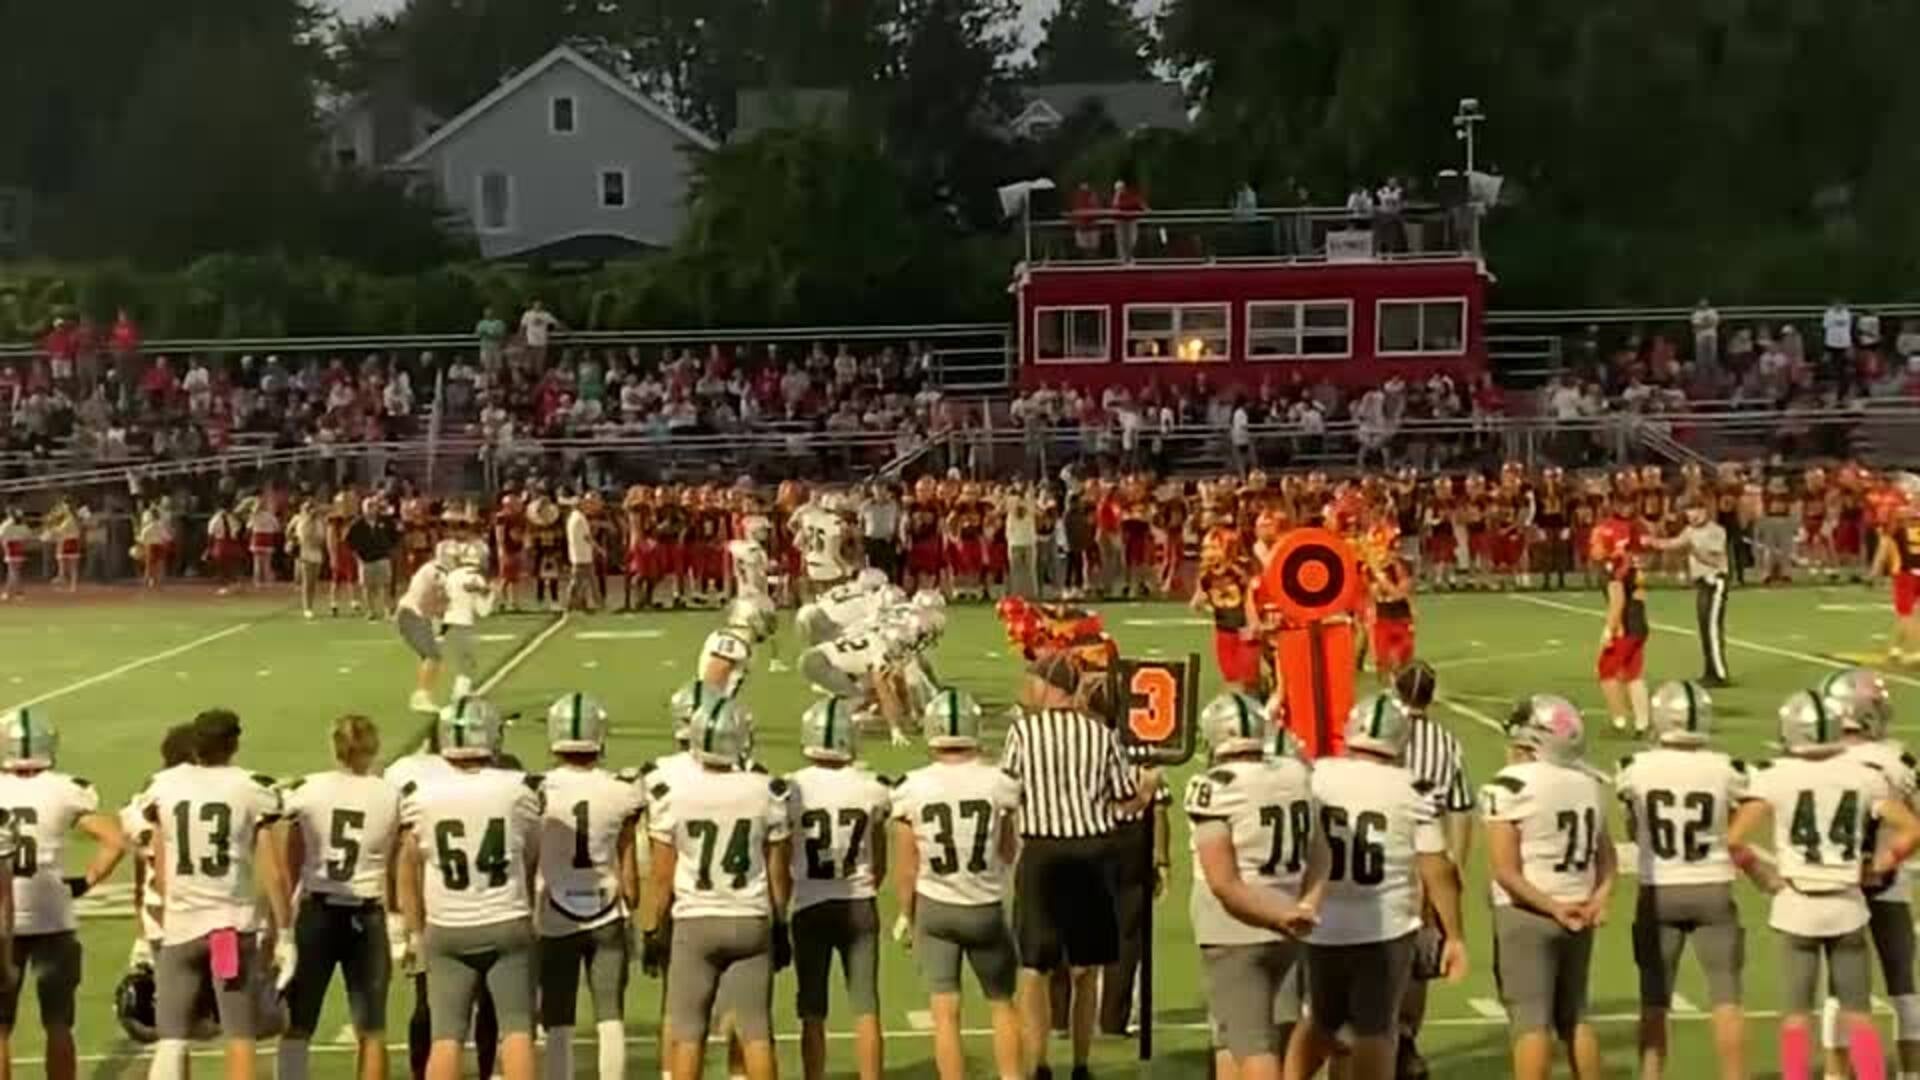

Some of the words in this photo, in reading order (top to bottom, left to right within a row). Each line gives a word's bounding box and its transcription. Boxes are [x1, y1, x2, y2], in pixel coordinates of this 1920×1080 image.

[1129, 667, 1176, 741] 3
[173, 799, 232, 877] 13
[326, 807, 366, 882] 5
[434, 816, 511, 891] 64
[572, 799, 593, 869] 1
[686, 817, 752, 890] 74
[801, 807, 869, 879] 27
[921, 799, 992, 874] 37
[1552, 806, 1595, 873] 71
[1646, 788, 1715, 863] 62
[1790, 789, 1858, 864] 44
